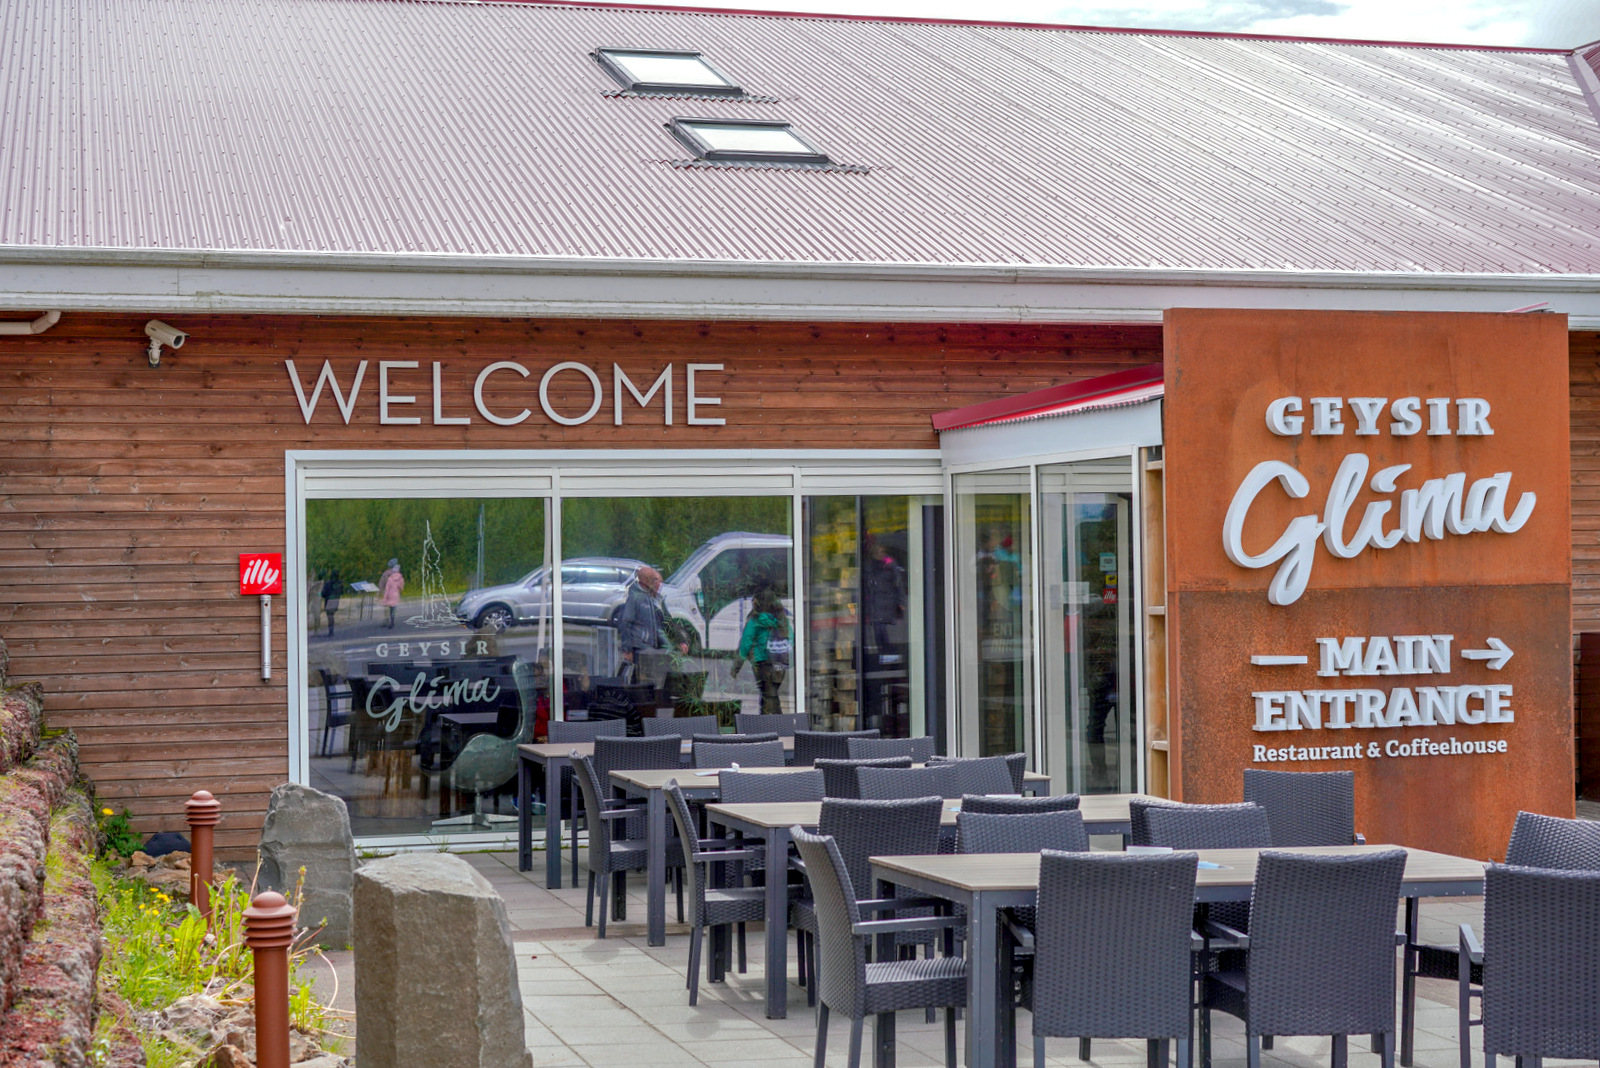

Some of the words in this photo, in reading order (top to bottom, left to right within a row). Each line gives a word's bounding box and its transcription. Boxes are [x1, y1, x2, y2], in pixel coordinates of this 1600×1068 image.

[285, 359, 727, 426] WELCOME
[1265, 396, 1494, 436] GEYSIR
[243, 558, 280, 591] illy
[375, 640, 489, 658] GEYSIR
[1316, 634, 1454, 677] MAIN
[1251, 684, 1514, 732] ENTRANCE
[1252, 742, 1363, 762] Restaurant
[1366, 742, 1381, 758] &
[1385, 737, 1508, 757] Coffeehouse
